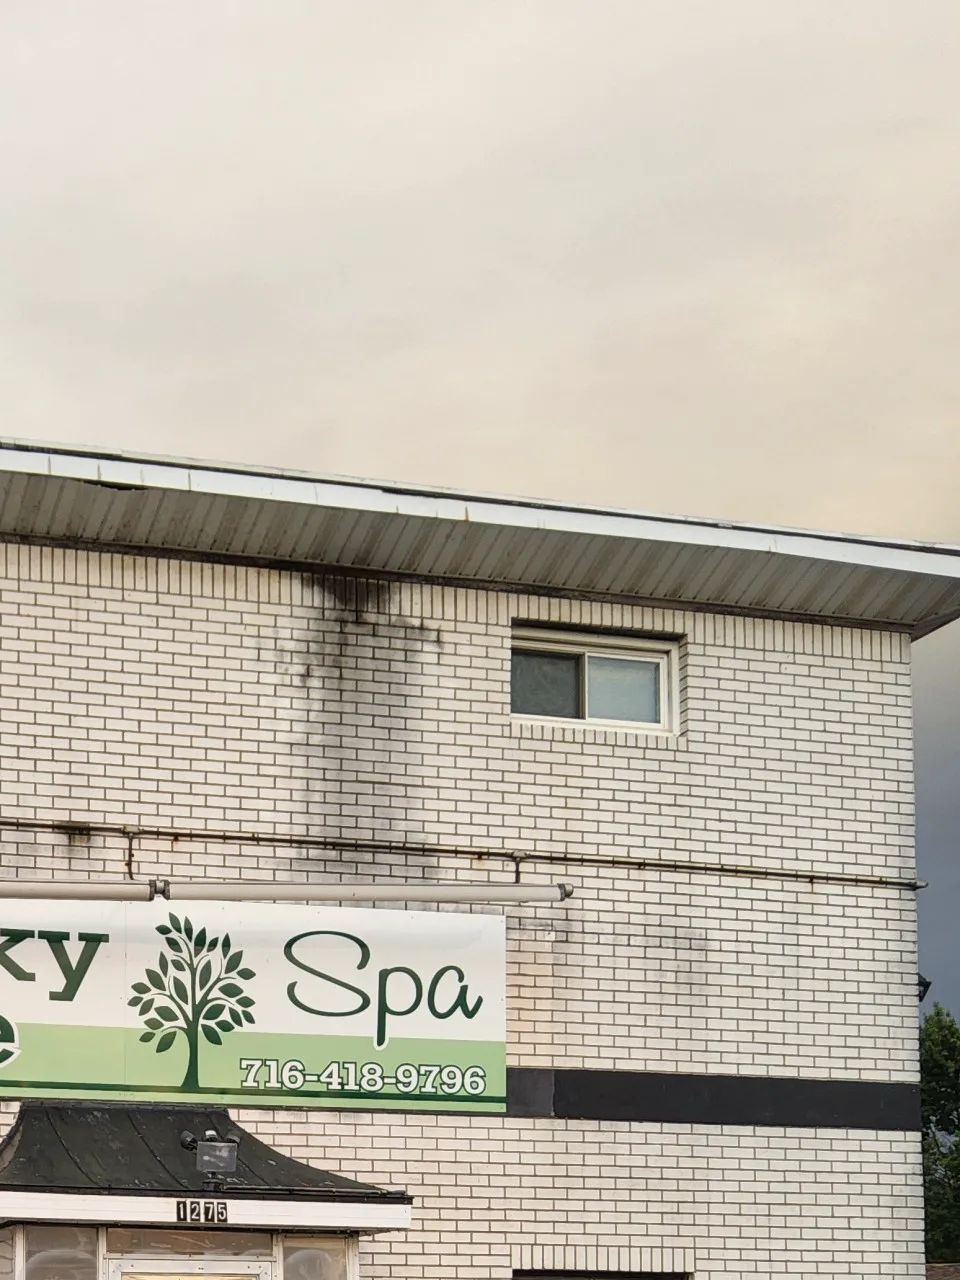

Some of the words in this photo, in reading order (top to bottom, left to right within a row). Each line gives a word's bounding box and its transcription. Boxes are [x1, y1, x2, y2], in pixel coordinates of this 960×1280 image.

[283, 930, 483, 1047] Spa
[240, 1058, 487, 1097] 716-418-9796
[178, 1202, 227, 1221] 1275
